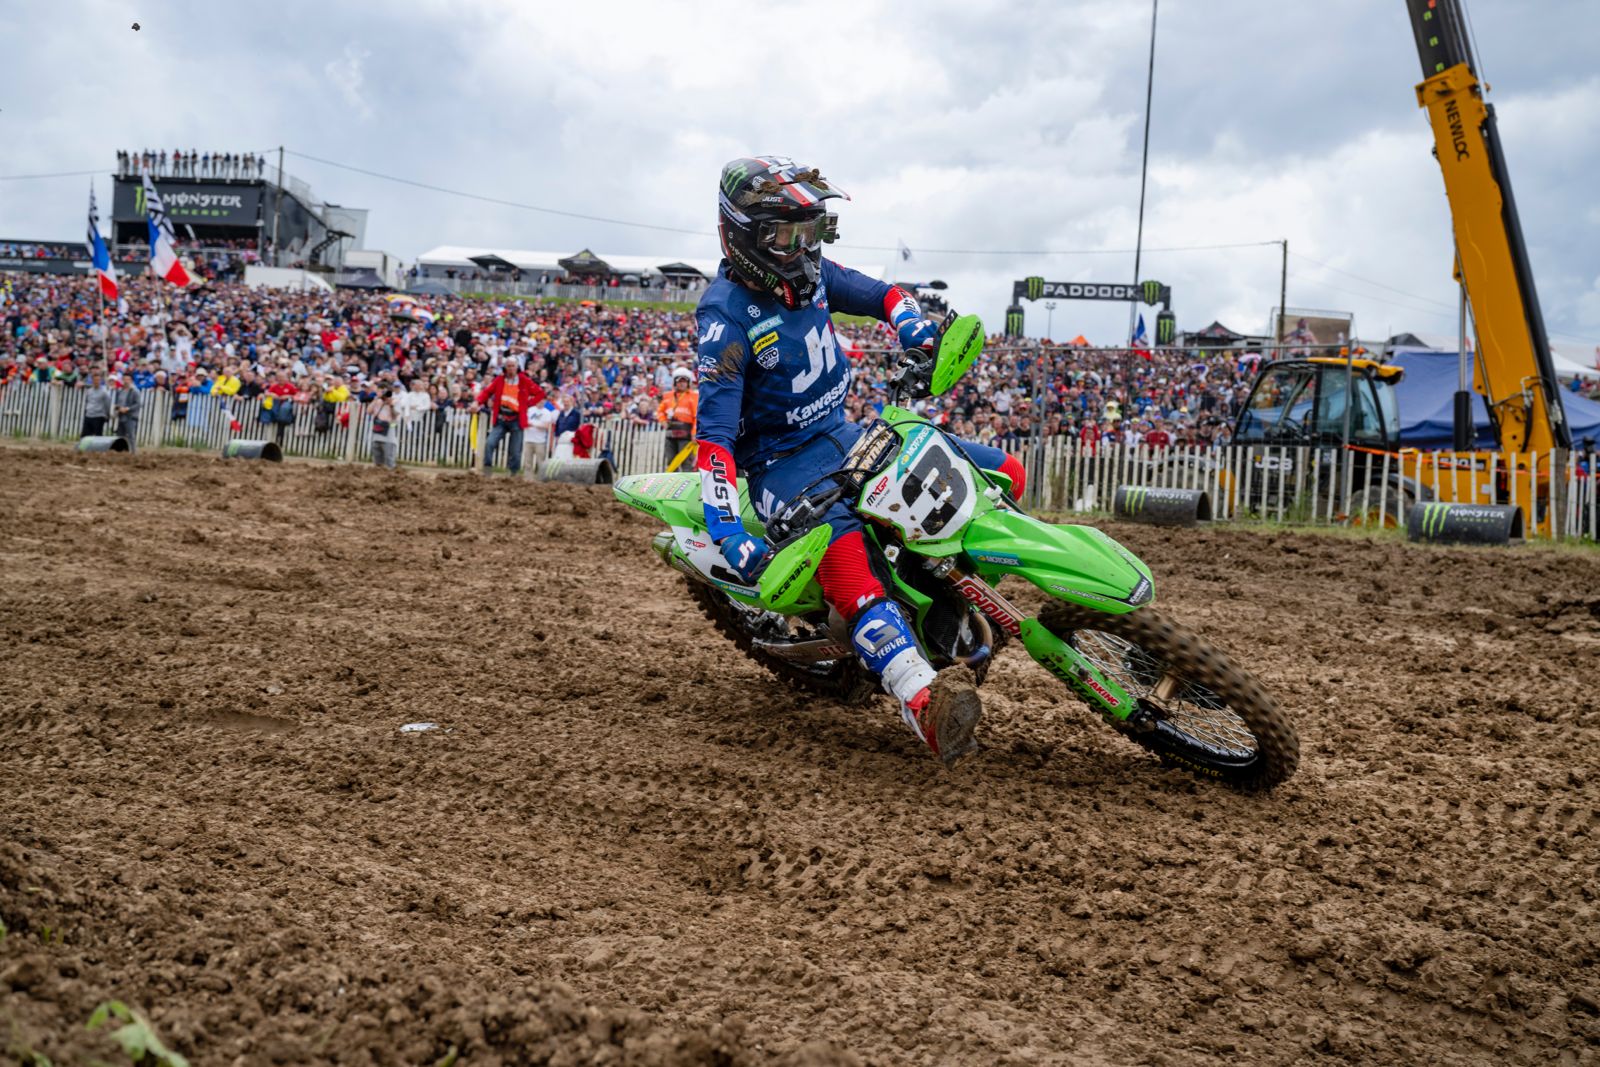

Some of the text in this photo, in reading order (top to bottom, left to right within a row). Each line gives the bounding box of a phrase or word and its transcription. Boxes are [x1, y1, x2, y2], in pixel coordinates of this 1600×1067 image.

[1445, 99, 1469, 161] NEWLOC
[162, 192, 242, 208] MONSTER
[171, 208, 231, 217] ENERGY
[728, 242, 765, 278] MONSTER
[1043, 284, 1137, 299] PADDOCK
[759, 350, 778, 365] MOTO
[785, 367, 850, 425] Kawasaki
[1254, 456, 1293, 471] JCB
[866, 476, 889, 506] MXGP
[901, 444, 967, 536] 3
[1146, 489, 1193, 501] MONSTER
[631, 497, 657, 512] DUNLOP
[1449, 508, 1505, 519] MONSTER
[986, 556, 1020, 567] MOTOREX
[1166, 752, 1221, 777] DUNLOP
